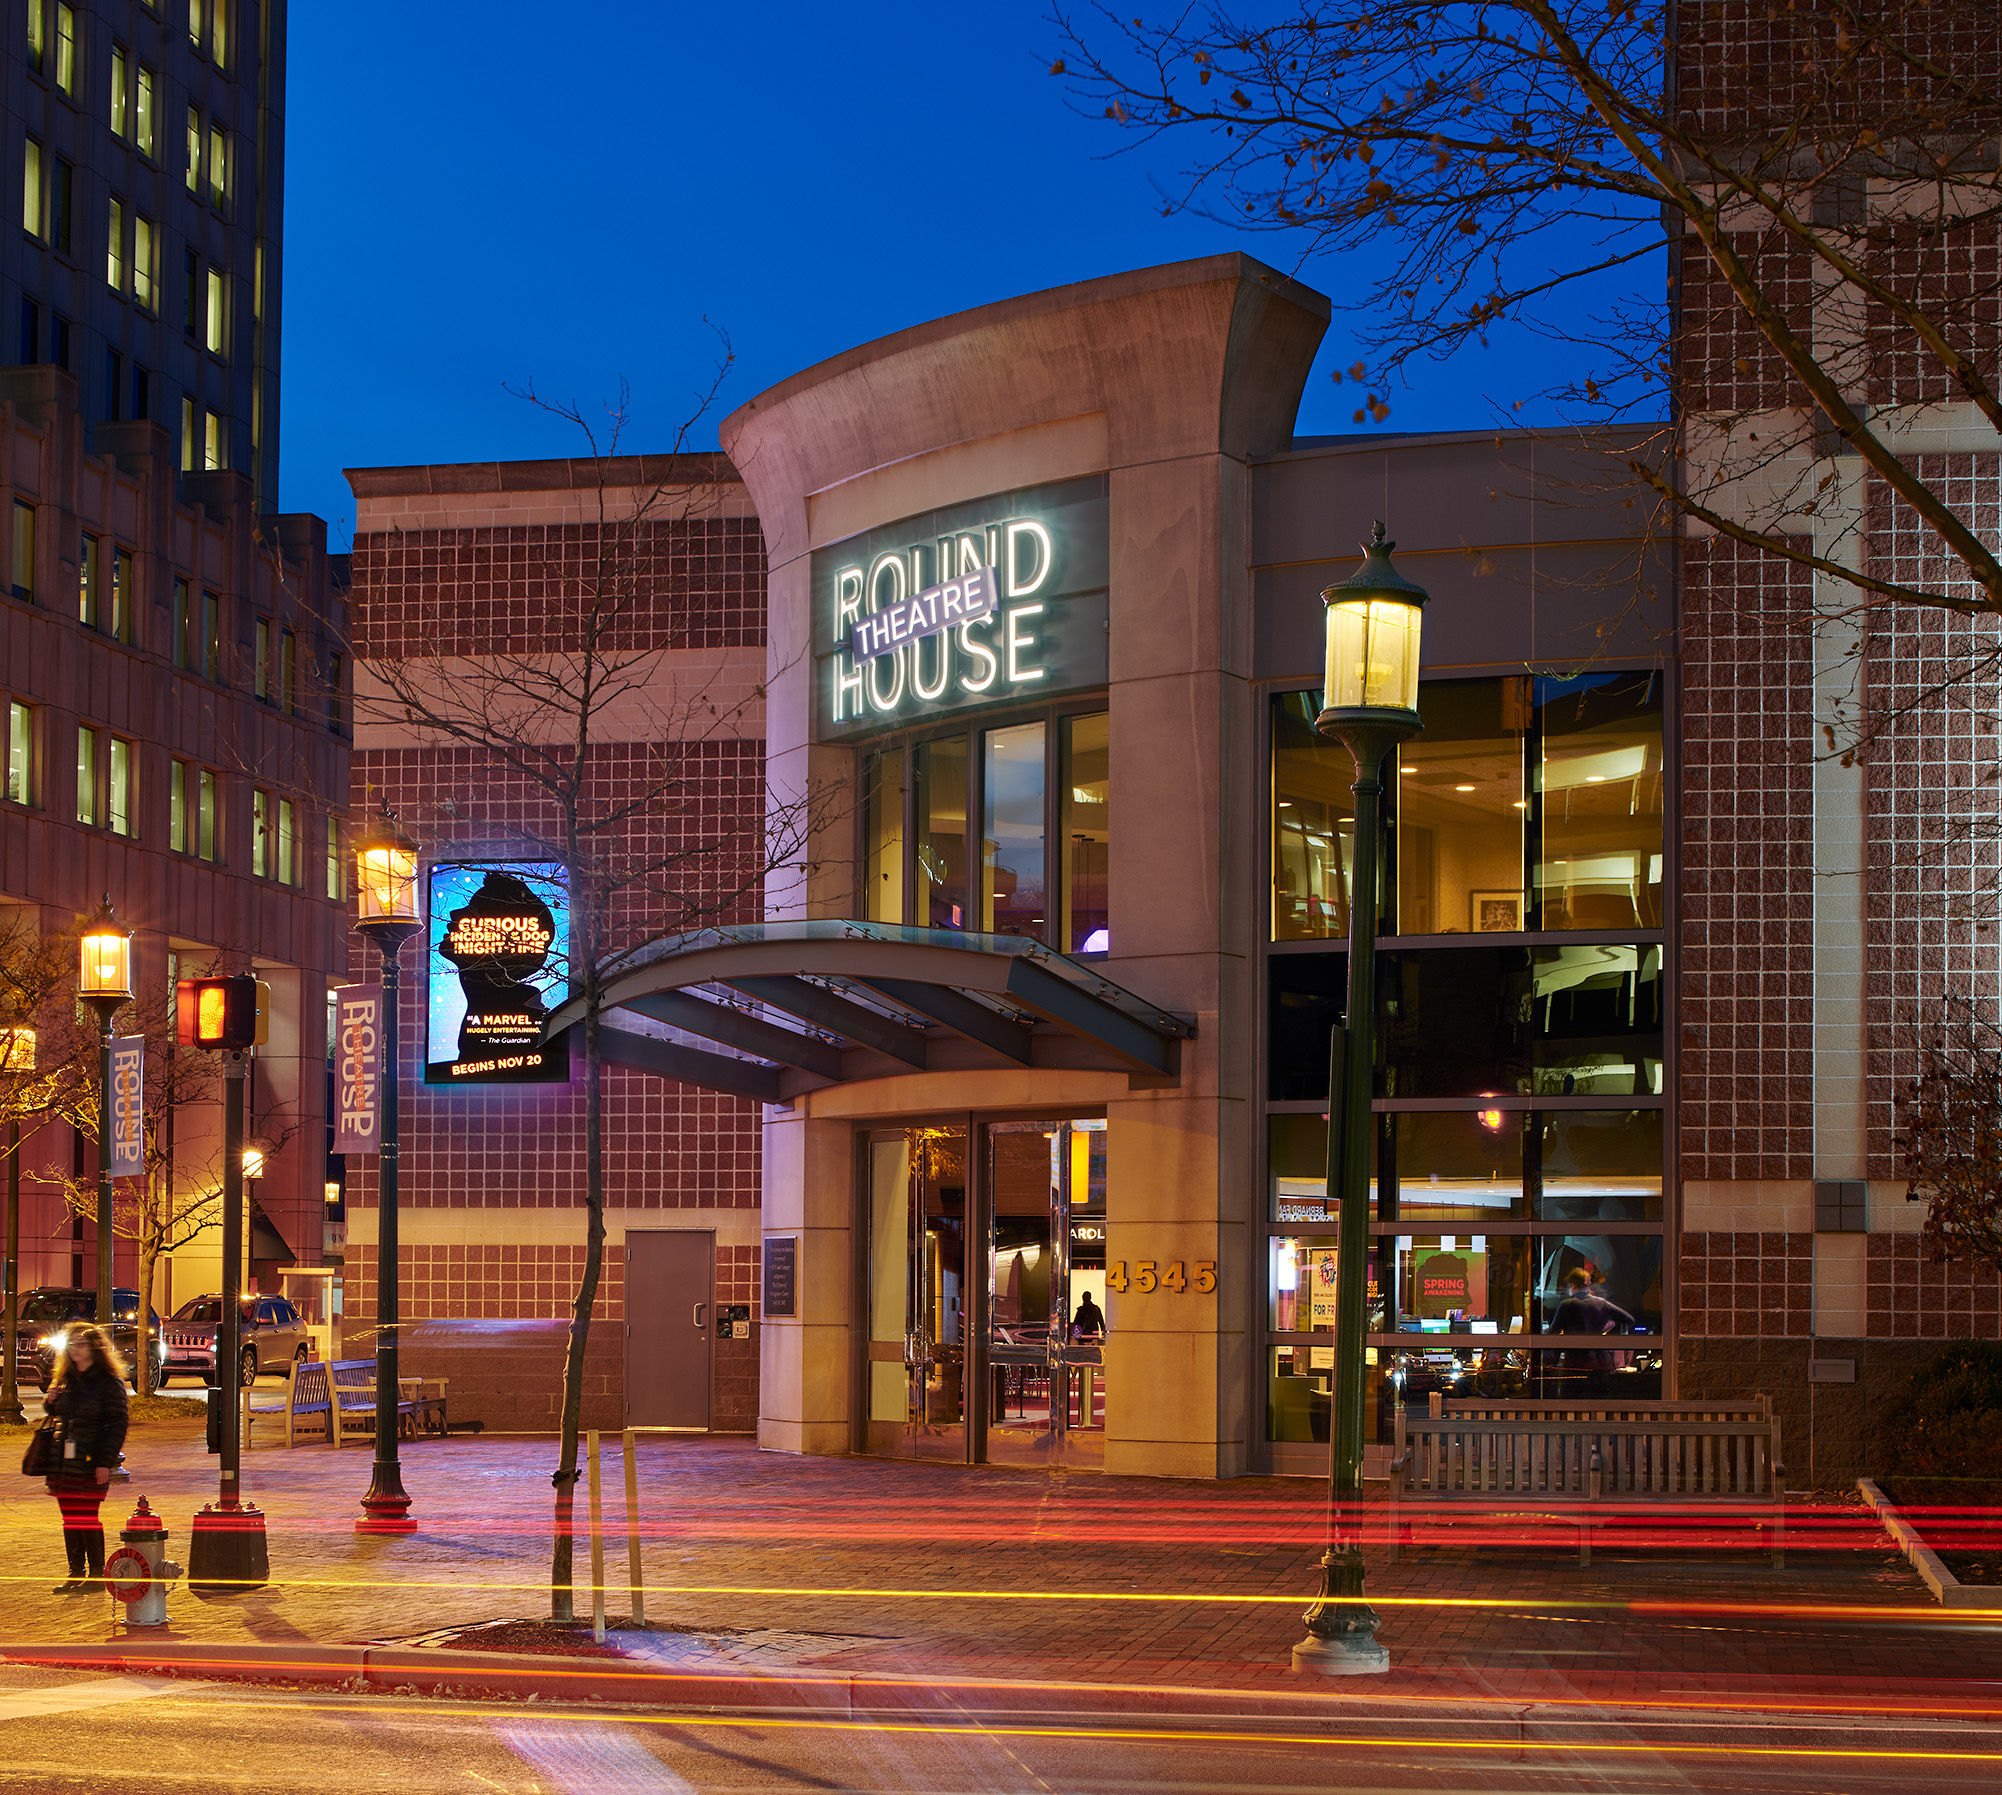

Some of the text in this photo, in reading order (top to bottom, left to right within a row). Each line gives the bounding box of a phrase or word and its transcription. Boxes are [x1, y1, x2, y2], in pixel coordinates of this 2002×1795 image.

[856, 575, 984, 655] THEATRE
[833, 603, 1044, 724] HOUSE
[458, 917, 539, 932] CURIOUS
[522, 931, 550, 941] DOG
[484, 1015, 532, 1025] MARVEL
[341, 1001, 357, 1133] HOUSE
[353, 1029, 365, 1108] THEATRE
[452, 1054, 542, 1076] BEGINS NOV 20
[1105, 1260, 1217, 1294] 4545
[1423, 1279, 1464, 1289] SPRING
[1314, 1304, 1325, 1315] FOR
[119, 1548, 132, 1558] OUT
[134, 1552, 144, 1562] OF
